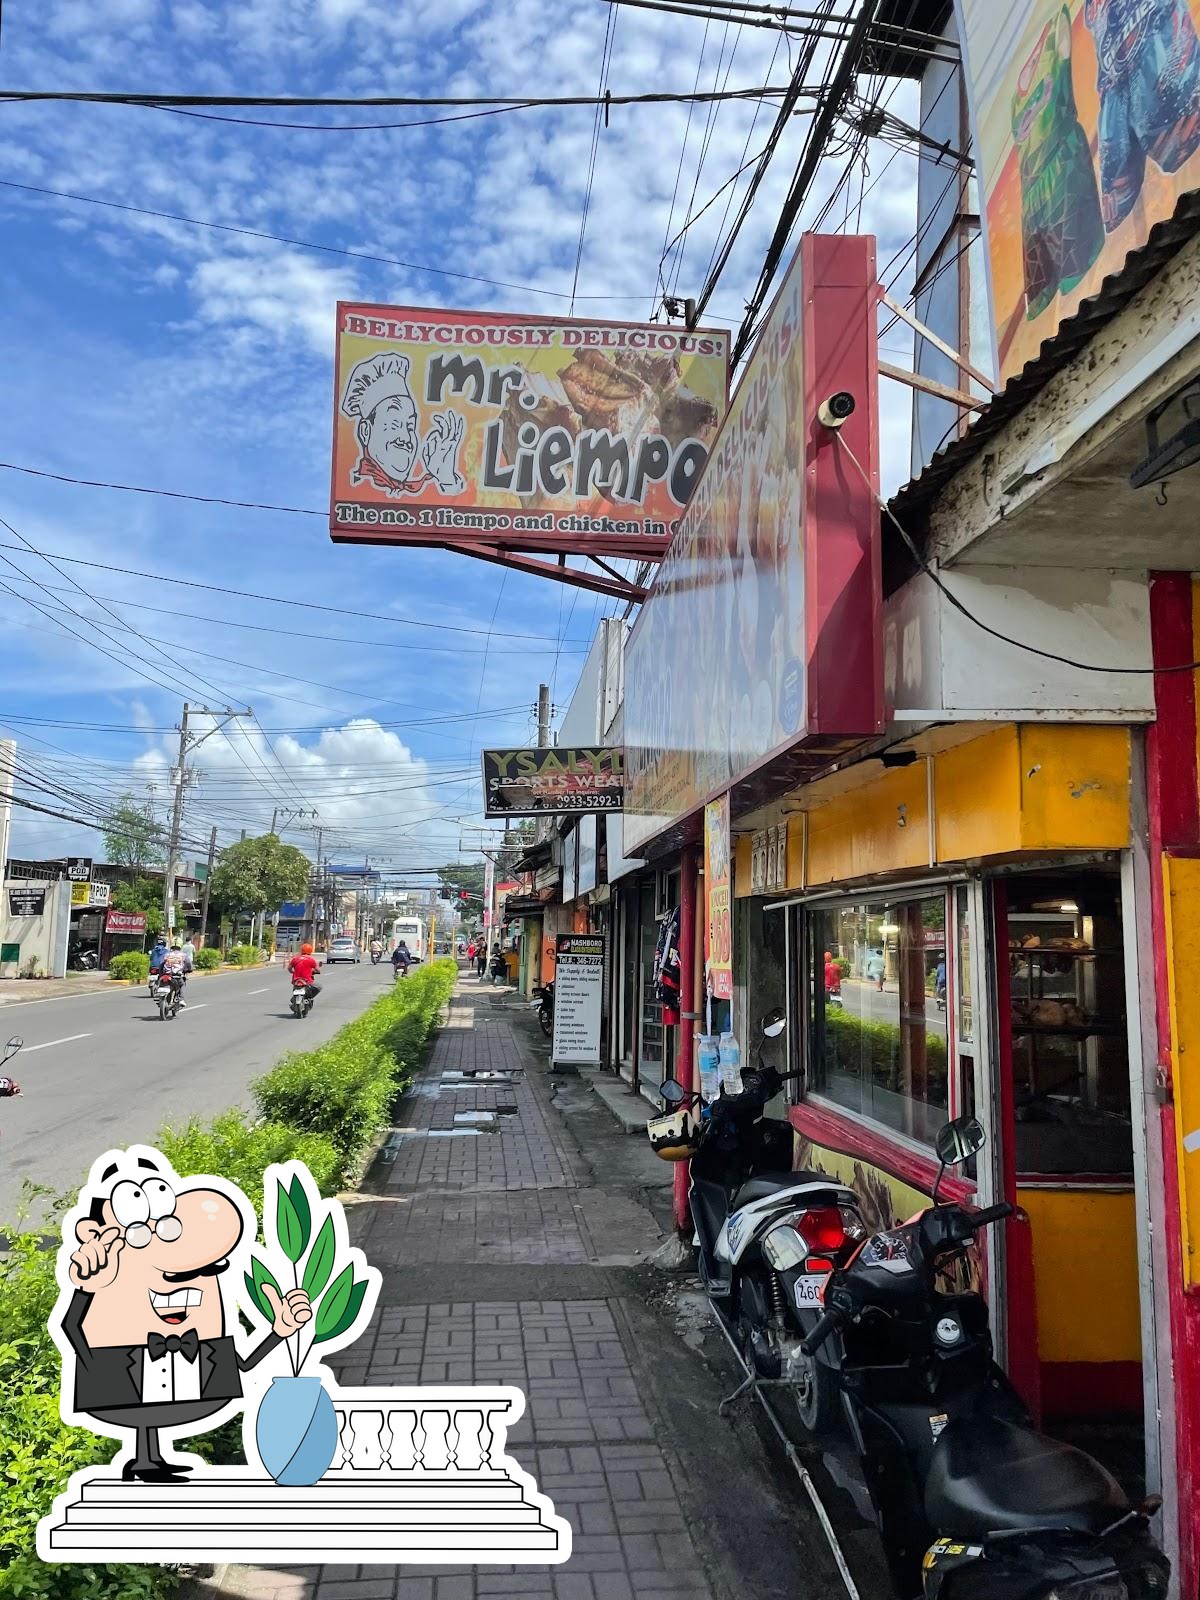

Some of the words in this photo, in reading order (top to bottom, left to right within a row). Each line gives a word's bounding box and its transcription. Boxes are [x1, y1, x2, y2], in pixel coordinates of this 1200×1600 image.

[345, 316, 553, 346] BELLYCIOUSLY
[562, 329, 722, 357] DELICIOUS!
[484, 421, 708, 505] Liempo
[337, 505, 377, 523] The
[382, 511, 414, 525] no.
[420, 511, 431, 525] 1
[437, 510, 509, 530] liempo
[514, 515, 554, 531] and
[558, 514, 640, 534] chicken
[644, 519, 665, 535] in
